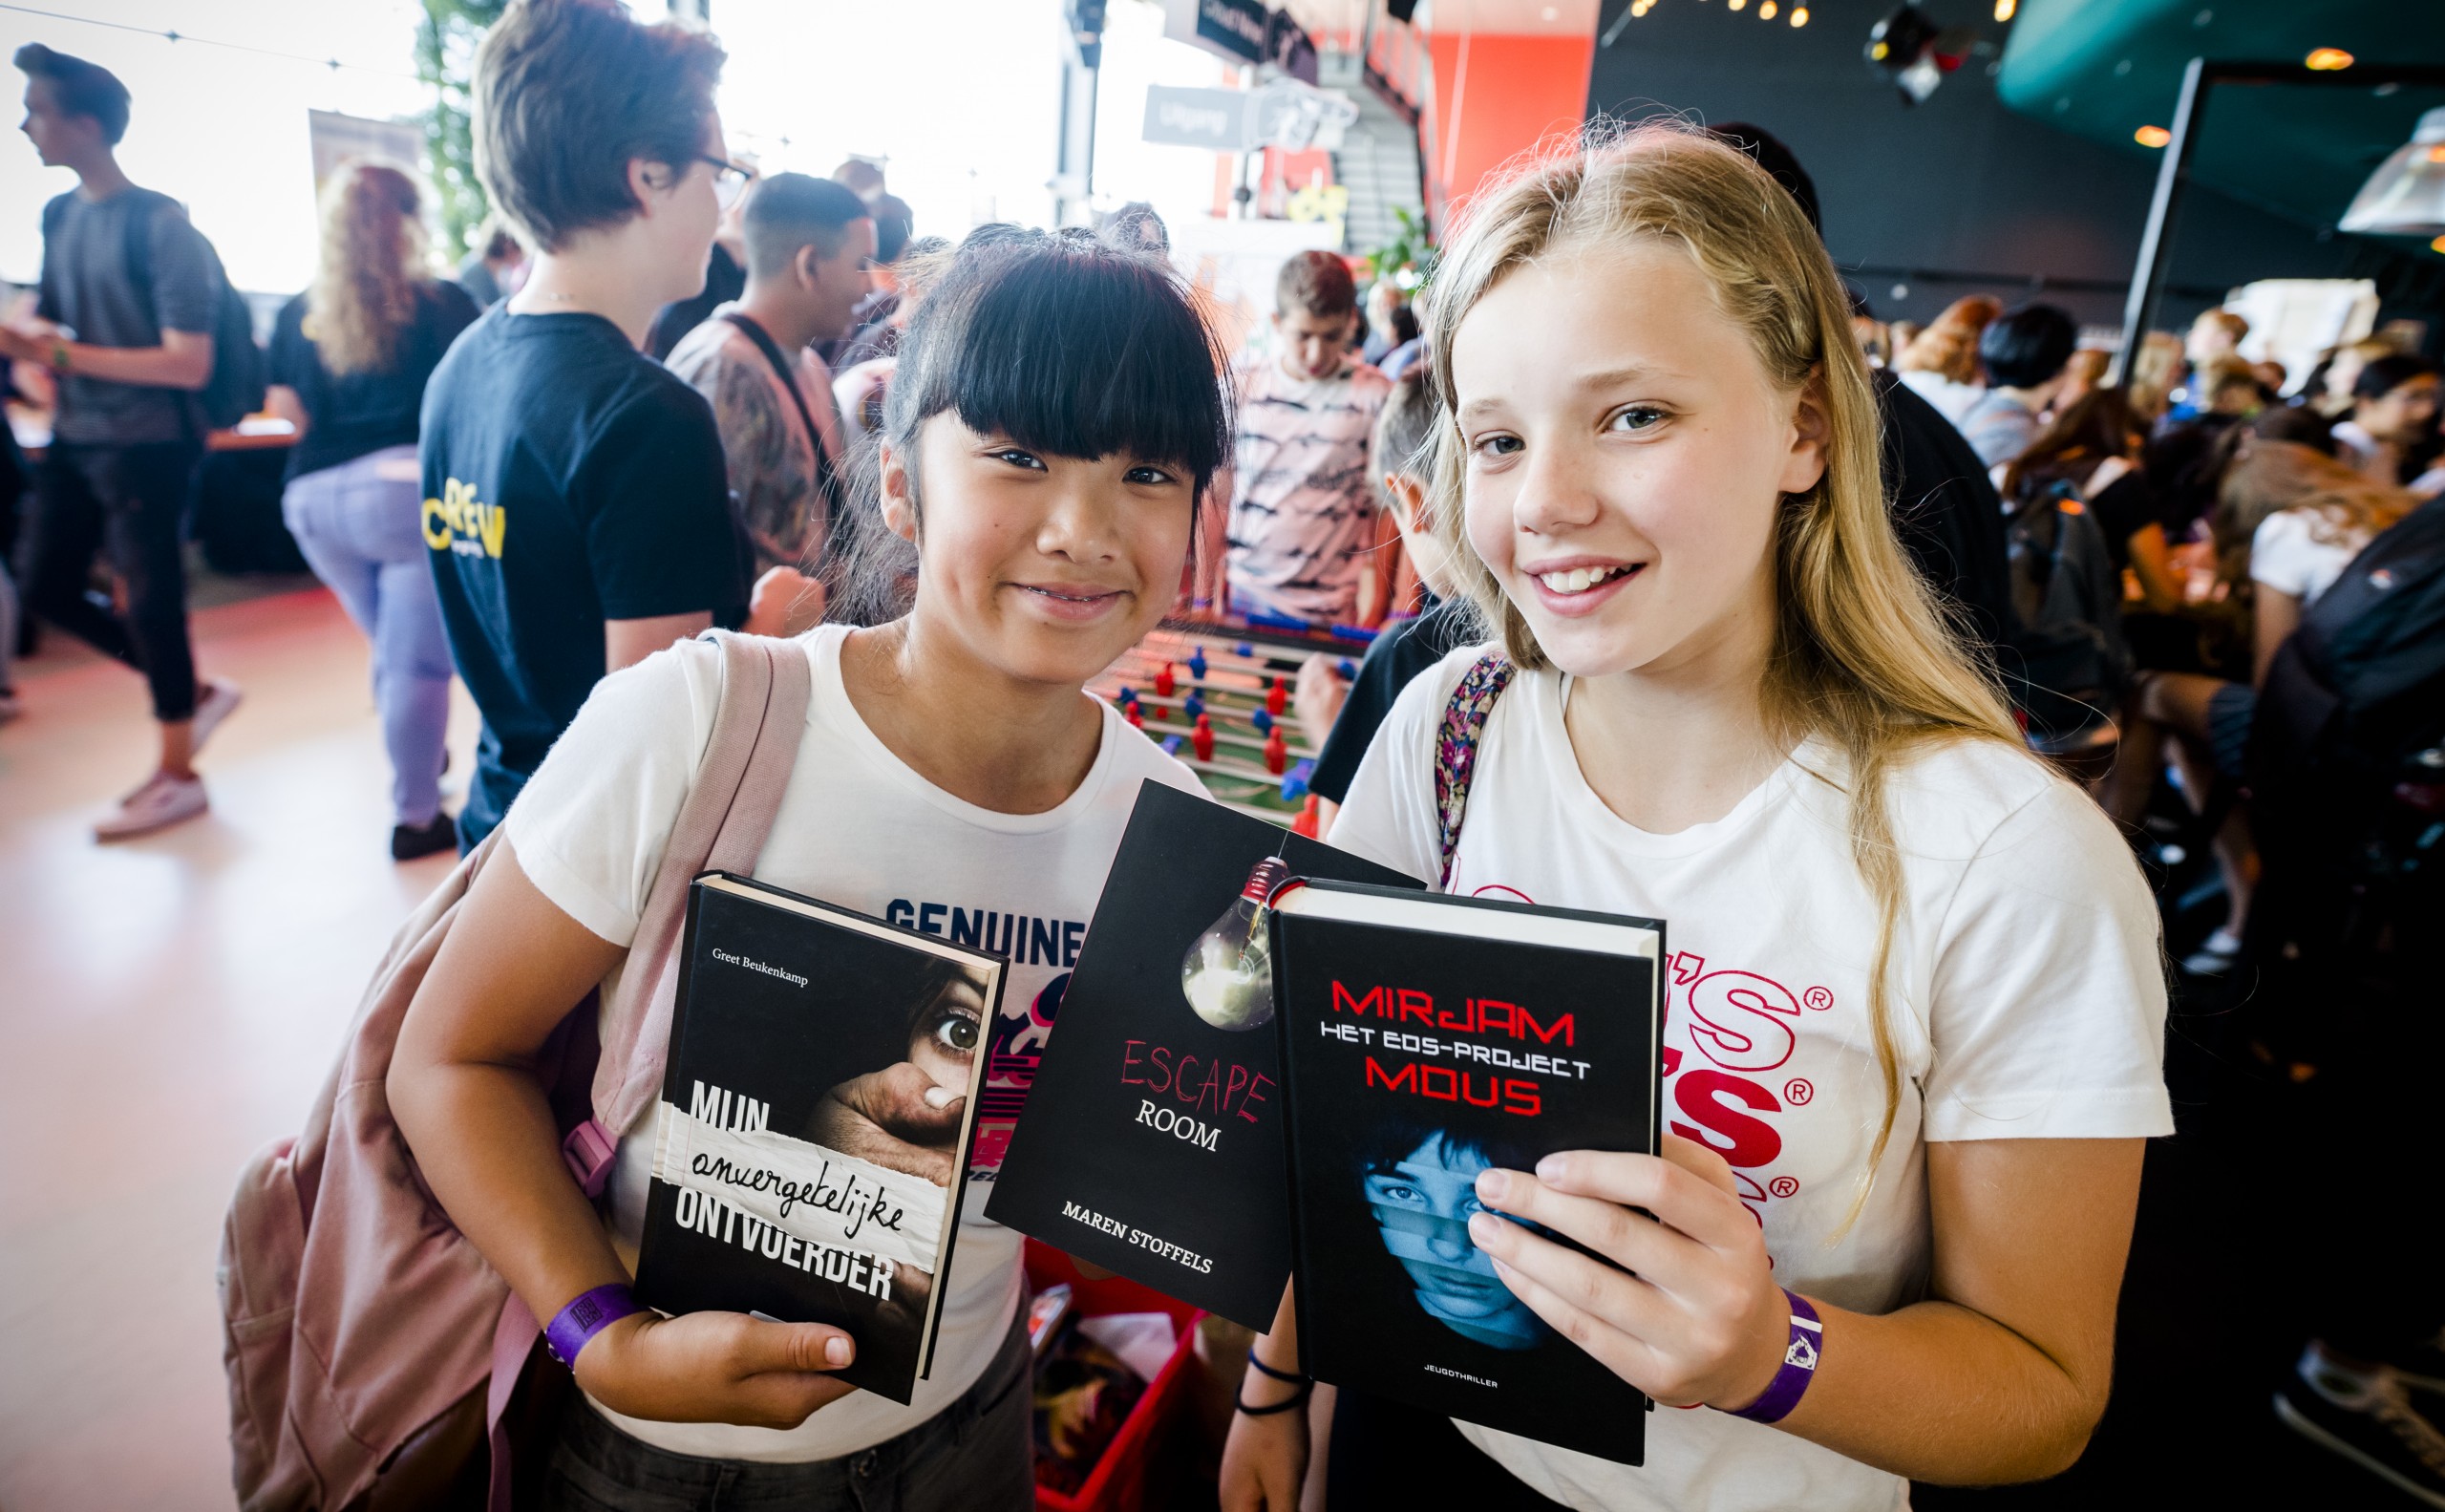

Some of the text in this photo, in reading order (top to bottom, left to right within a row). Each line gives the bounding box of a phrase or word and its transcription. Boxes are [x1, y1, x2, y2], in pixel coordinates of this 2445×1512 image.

[421, 478, 506, 560] CREW
[712, 948, 809, 988] Greet Beukenkamp
[1331, 980, 1575, 1048] MIRJAM
[1121, 1039, 1277, 1123] ESCAPE
[1320, 1020, 1591, 1080] HET EOS-PROJECT
[690, 1079, 770, 1133] MIJN
[1365, 1056, 1542, 1118] MOUS
[1135, 1099, 1222, 1152] ROOM
[691, 1153, 904, 1240] onvergetelijke
[674, 1186, 895, 1302] ONTVOERDER
[1061, 1201, 1213, 1274] MAREN STOFFELS
[1424, 1364, 1498, 1389] JEUGDTHRILLER
